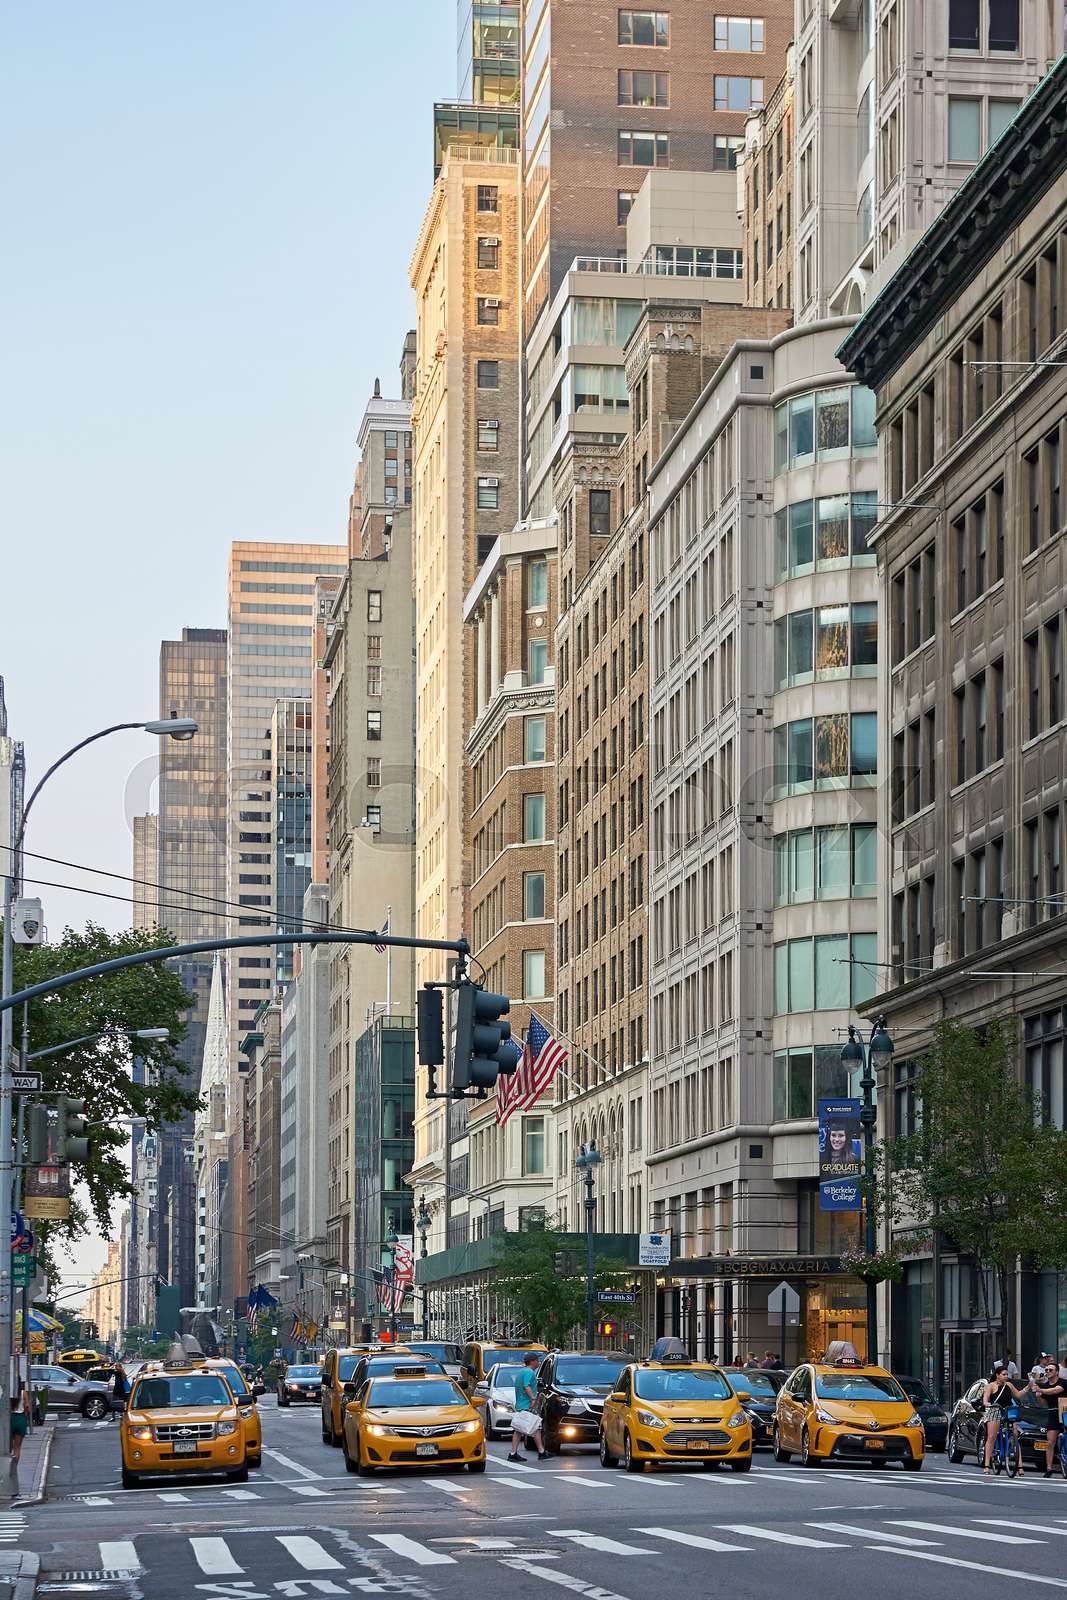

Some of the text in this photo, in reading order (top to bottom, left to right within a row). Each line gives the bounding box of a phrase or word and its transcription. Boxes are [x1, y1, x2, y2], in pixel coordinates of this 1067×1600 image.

[13, 1079, 35, 1087] WAY
[822, 1163, 858, 1171] GRADUATE
[831, 1186, 856, 1194] Berkeley
[832, 1193, 856, 1201] College
